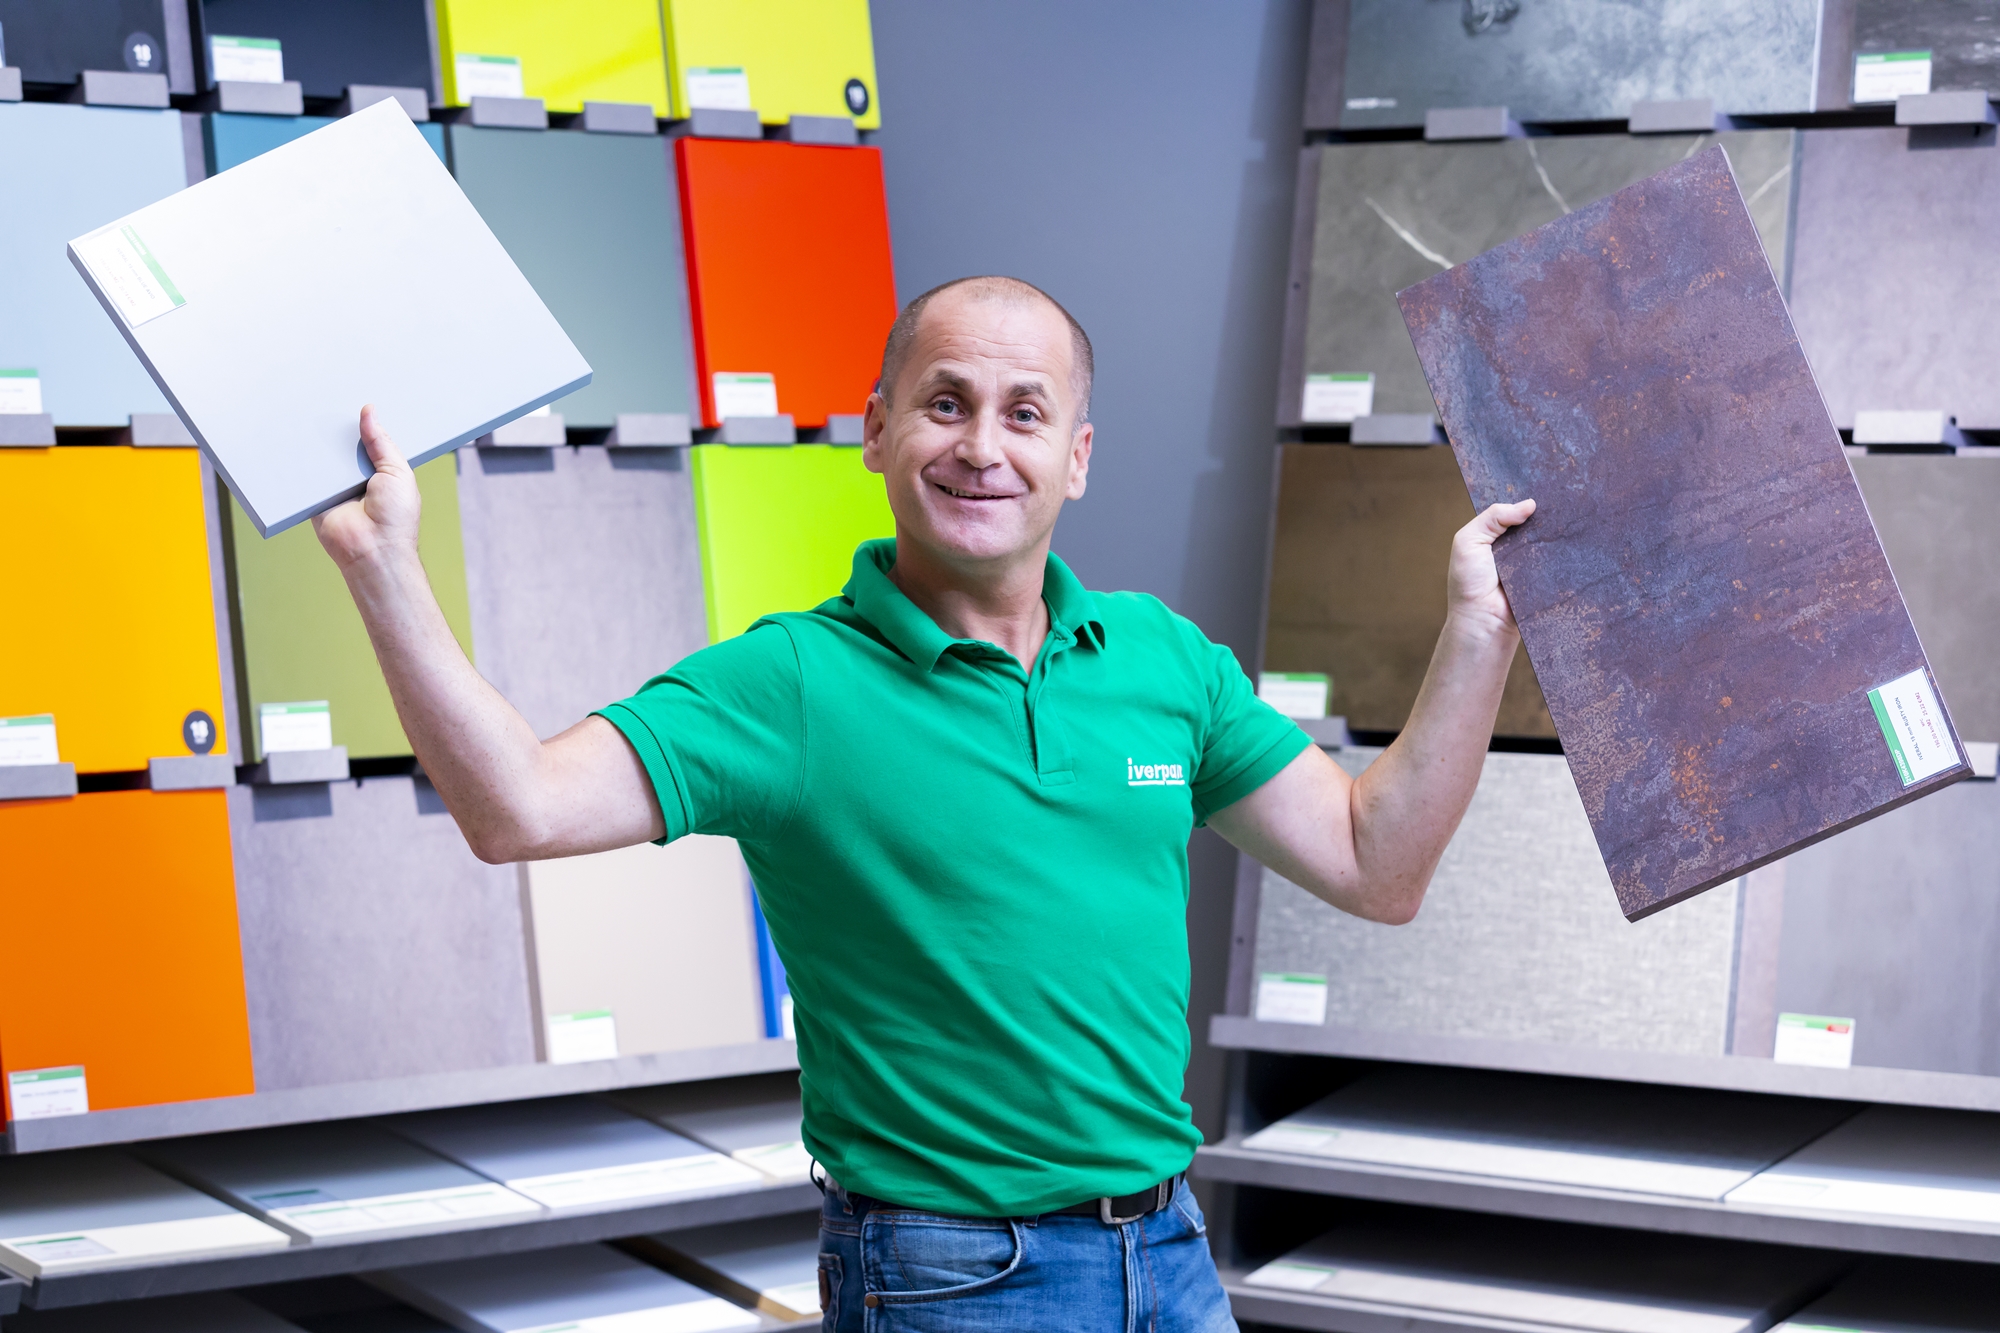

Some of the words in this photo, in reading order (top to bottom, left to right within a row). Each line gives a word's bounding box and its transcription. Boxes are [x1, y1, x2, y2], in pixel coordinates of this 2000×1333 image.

[1894, 697, 1903, 710] IRON
[1900, 710, 1909, 727] RUSTY
[1913, 743, 1923, 760] IVERAL
